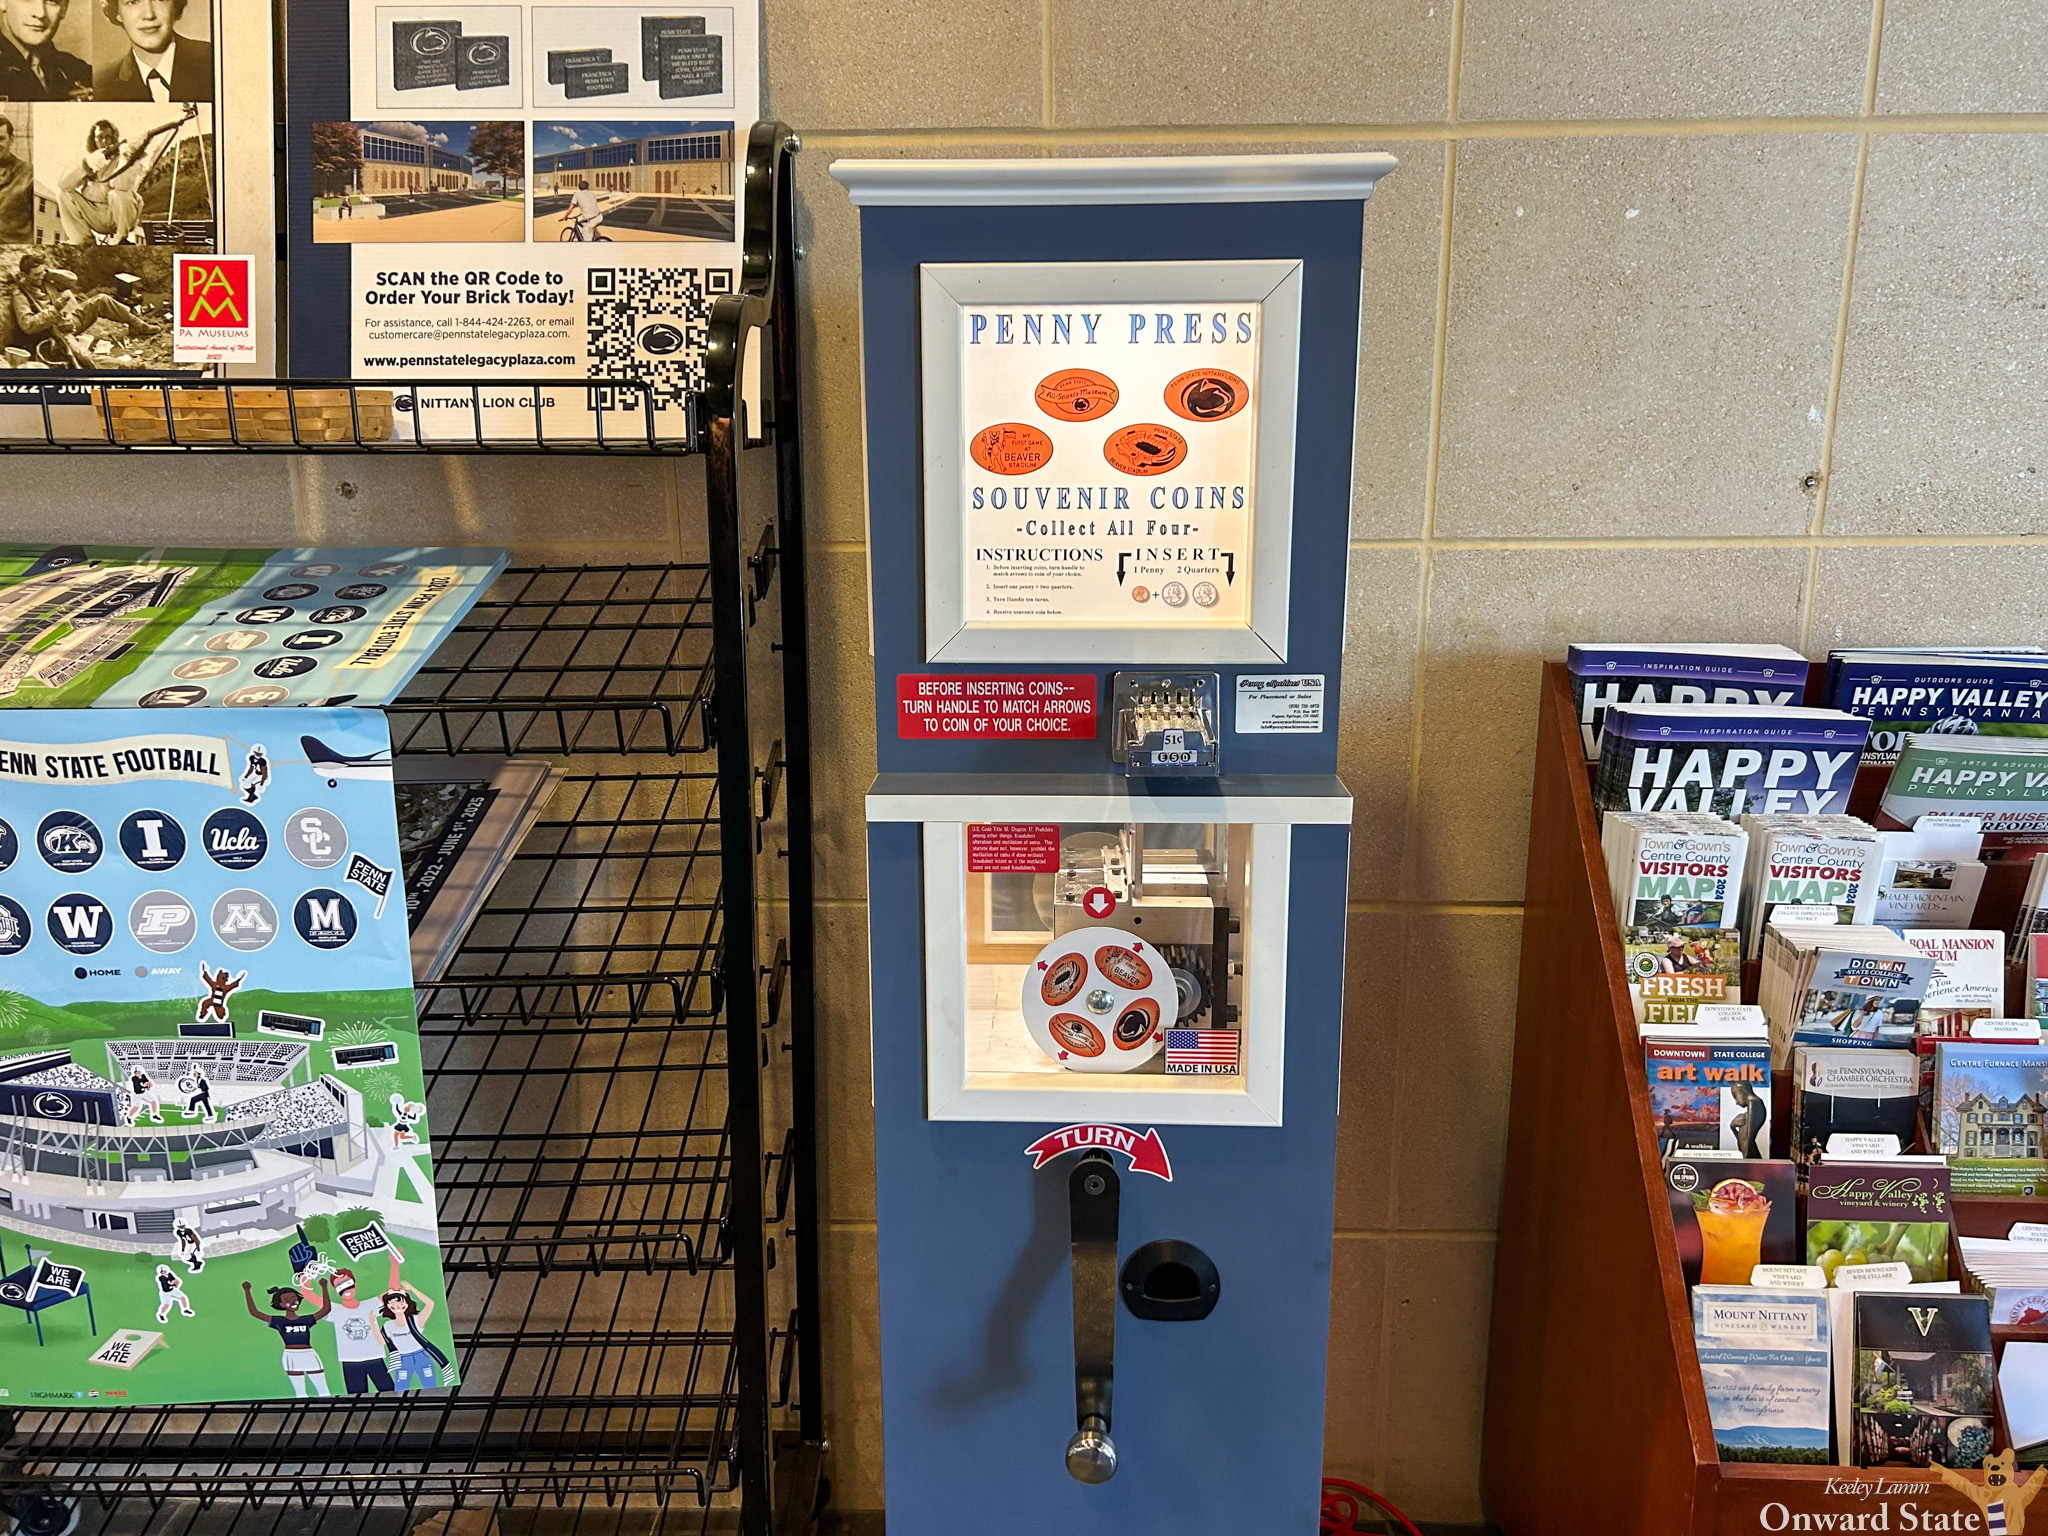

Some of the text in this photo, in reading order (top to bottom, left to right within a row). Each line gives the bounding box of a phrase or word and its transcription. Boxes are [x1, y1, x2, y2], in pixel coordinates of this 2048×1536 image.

[376, 271, 563, 286] SCAN the QR Code to
[365, 289, 574, 305] Order Your Brick Today!
[365, 318, 380, 327] For
[383, 318, 434, 328] assistance,
[437, 318, 452, 326] call
[455, 317, 533, 327] 1-844-424-2263,
[549, 317, 574, 326] email
[970, 312, 1252, 344] PENNY PRESS
[369, 330, 570, 340] customercare@pennstatelegacyplaza.com.
[364, 354, 575, 368] www.pennstatelegacyplaza.com
[1080, 388, 1108, 397] Museum
[483, 398, 514, 408] LION
[1004, 453, 1040, 462] BEAVER
[972, 486, 1244, 510] SOUVENIR COINS
[1016, 520, 1199, 536] -Collect All Four-
[976, 548, 1103, 561] INSTRUCTIONS
[1135, 548, 1220, 561] INSERT
[1140, 566, 1165, 575] Penny
[1176, 566, 1220, 575] 2 Quarters
[1643, 664, 1733, 674] INSPIRATION GUIDE
[918, 682, 1074, 696] BEFORE INSERTING COINS--
[1852, 687, 2048, 708] HAPPY VALLEY
[903, 700, 1091, 714] TURN HANDLE TO MATCH ARROWS
[1850, 706, 2041, 718] PENNSYLVANIA
[924, 718, 1071, 732] TO COIN OF YOUR CHOICE.
[45, 755, 109, 778] STATE
[112, 748, 220, 776] FOOTBALL
[1628, 747, 1855, 789] HAPPY
[1911, 767, 2018, 787] HAPPY
[1641, 850, 1730, 865] Centre County
[1771, 853, 1865, 869] Centre County
[355, 861, 386, 883] PENN
[1639, 862, 1728, 877] VISITORS
[1770, 865, 1862, 881] VISITORS
[350, 869, 385, 892] STATE
[1637, 877, 1715, 899] MAP
[1714, 879, 1727, 900] 2024
[1767, 880, 1847, 902] MAP
[1845, 883, 1859, 904] 2024
[1913, 894, 1965, 902] MOUNTAIN
[1888, 902, 1941, 910] VINEYARDS
[1942, 939, 1995, 950] MANSION
[151, 967, 182, 975] AWAY
[1851, 960, 1904, 971] DOWN
[89, 969, 121, 977] HOME
[1643, 977, 1723, 997] FRESH
[1848, 976, 1898, 987] TOWN
[1961, 984, 1998, 992] America
[1831, 1038, 1872, 1046] SHOPPING
[1654, 1050, 1705, 1058] DOWNTOWN
[1166, 1064, 1237, 1074] MADE IN USA
[1950, 1059, 2019, 1068] CENTRE FURNACE
[1657, 1063, 1764, 1081] art walk
[1839, 1067, 1895, 1075] PENNSYLVANIA
[1827, 1074, 1913, 1083] CHAMBER ORCHESTRA
[1054, 1127, 1135, 1152] TURN
[1812, 1178, 1922, 1200] Happy Valley
[344, 1230, 377, 1248] PENN
[348, 1236, 385, 1256] STATE
[49, 1266, 70, 1279] WE
[46, 1275, 72, 1288] ARE
[1714, 1310, 1808, 1321] MOUNT NITTANY
[110, 1341, 133, 1354] WE
[98, 1350, 132, 1364] ARE
